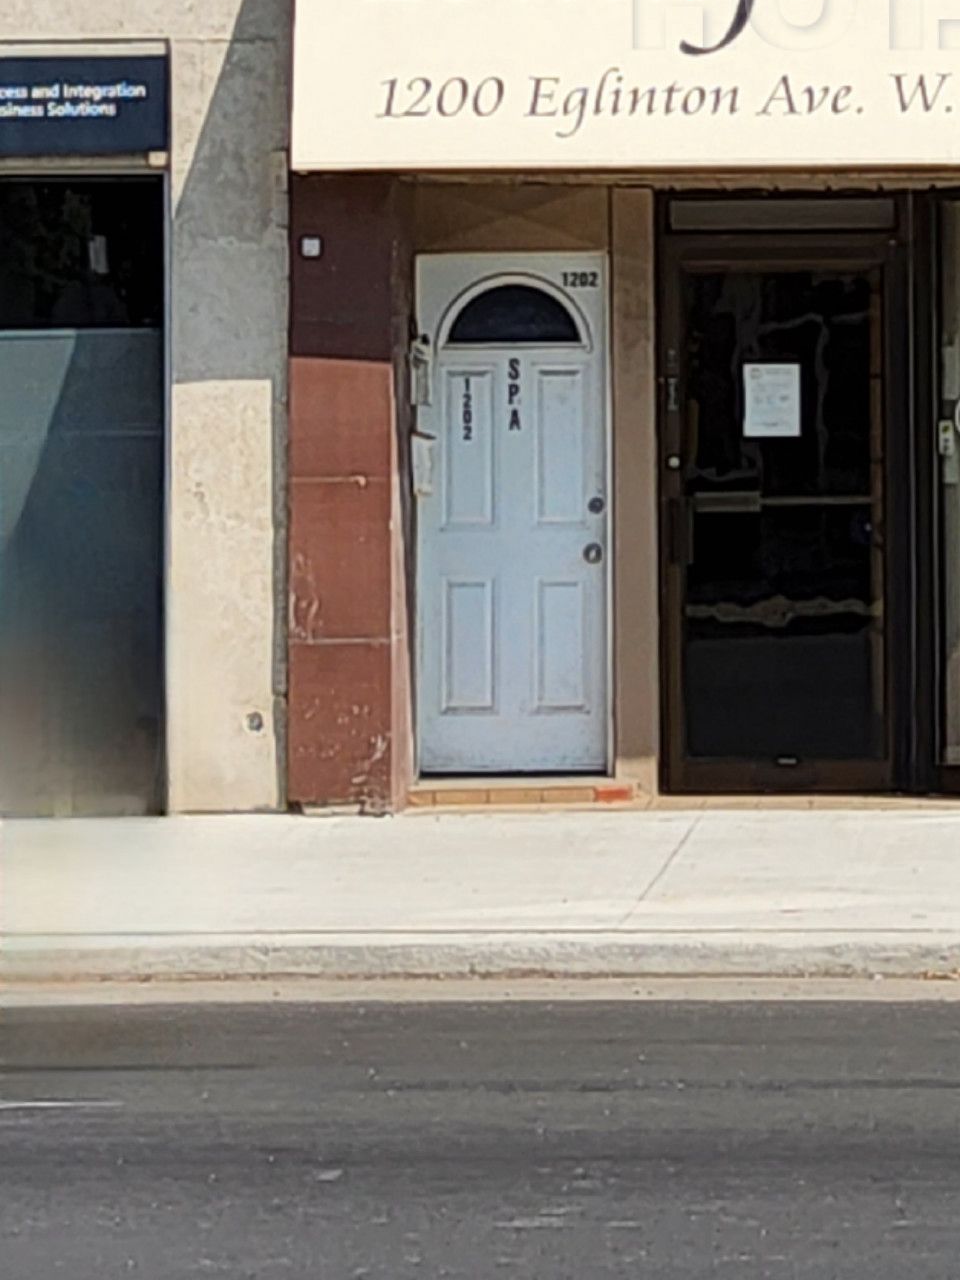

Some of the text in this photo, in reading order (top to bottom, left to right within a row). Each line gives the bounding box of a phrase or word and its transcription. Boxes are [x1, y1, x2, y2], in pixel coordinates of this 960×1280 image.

[31, 83, 60, 98] and
[63, 81, 146, 101] Integration
[47, 101, 116, 117] Solutions
[374, 75, 505, 119] 1200
[523, 67, 740, 138] Eglinton
[755, 73, 864, 117] Ave.
[890, 73, 954, 114] W.
[561, 272, 598, 287] 1202
[462, 377, 473, 440] 1202
[508, 358, 521, 430] SPA
